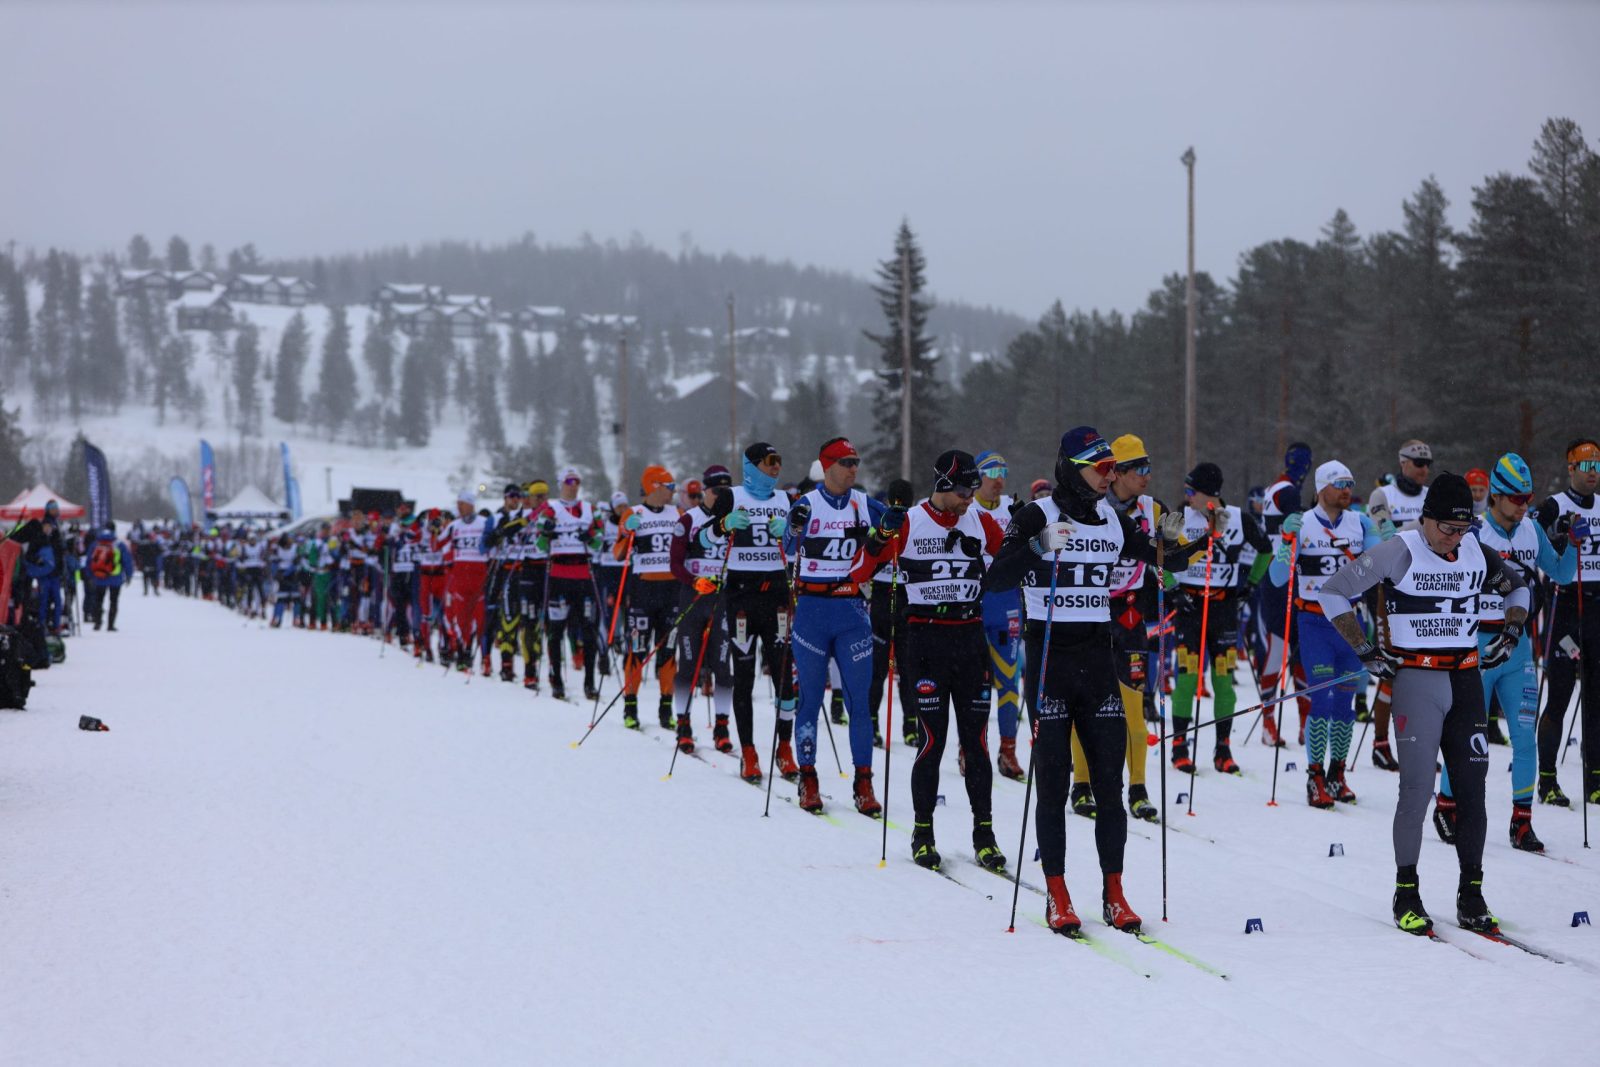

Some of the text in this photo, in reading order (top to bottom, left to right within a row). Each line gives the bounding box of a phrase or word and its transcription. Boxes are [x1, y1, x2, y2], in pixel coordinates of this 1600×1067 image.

[822, 538, 857, 560] 40
[931, 560, 970, 579] 27
[1067, 563, 1108, 586] 13
[1413, 571, 1464, 582] WICKSTRÖM
[919, 583, 960, 595] WICKSTRÖM
[1416, 582, 1460, 591] COACHING
[1435, 597, 1475, 614] 11
[1410, 617, 1462, 628] WICKSTRÖM
[1416, 628, 1459, 637] COACHING
